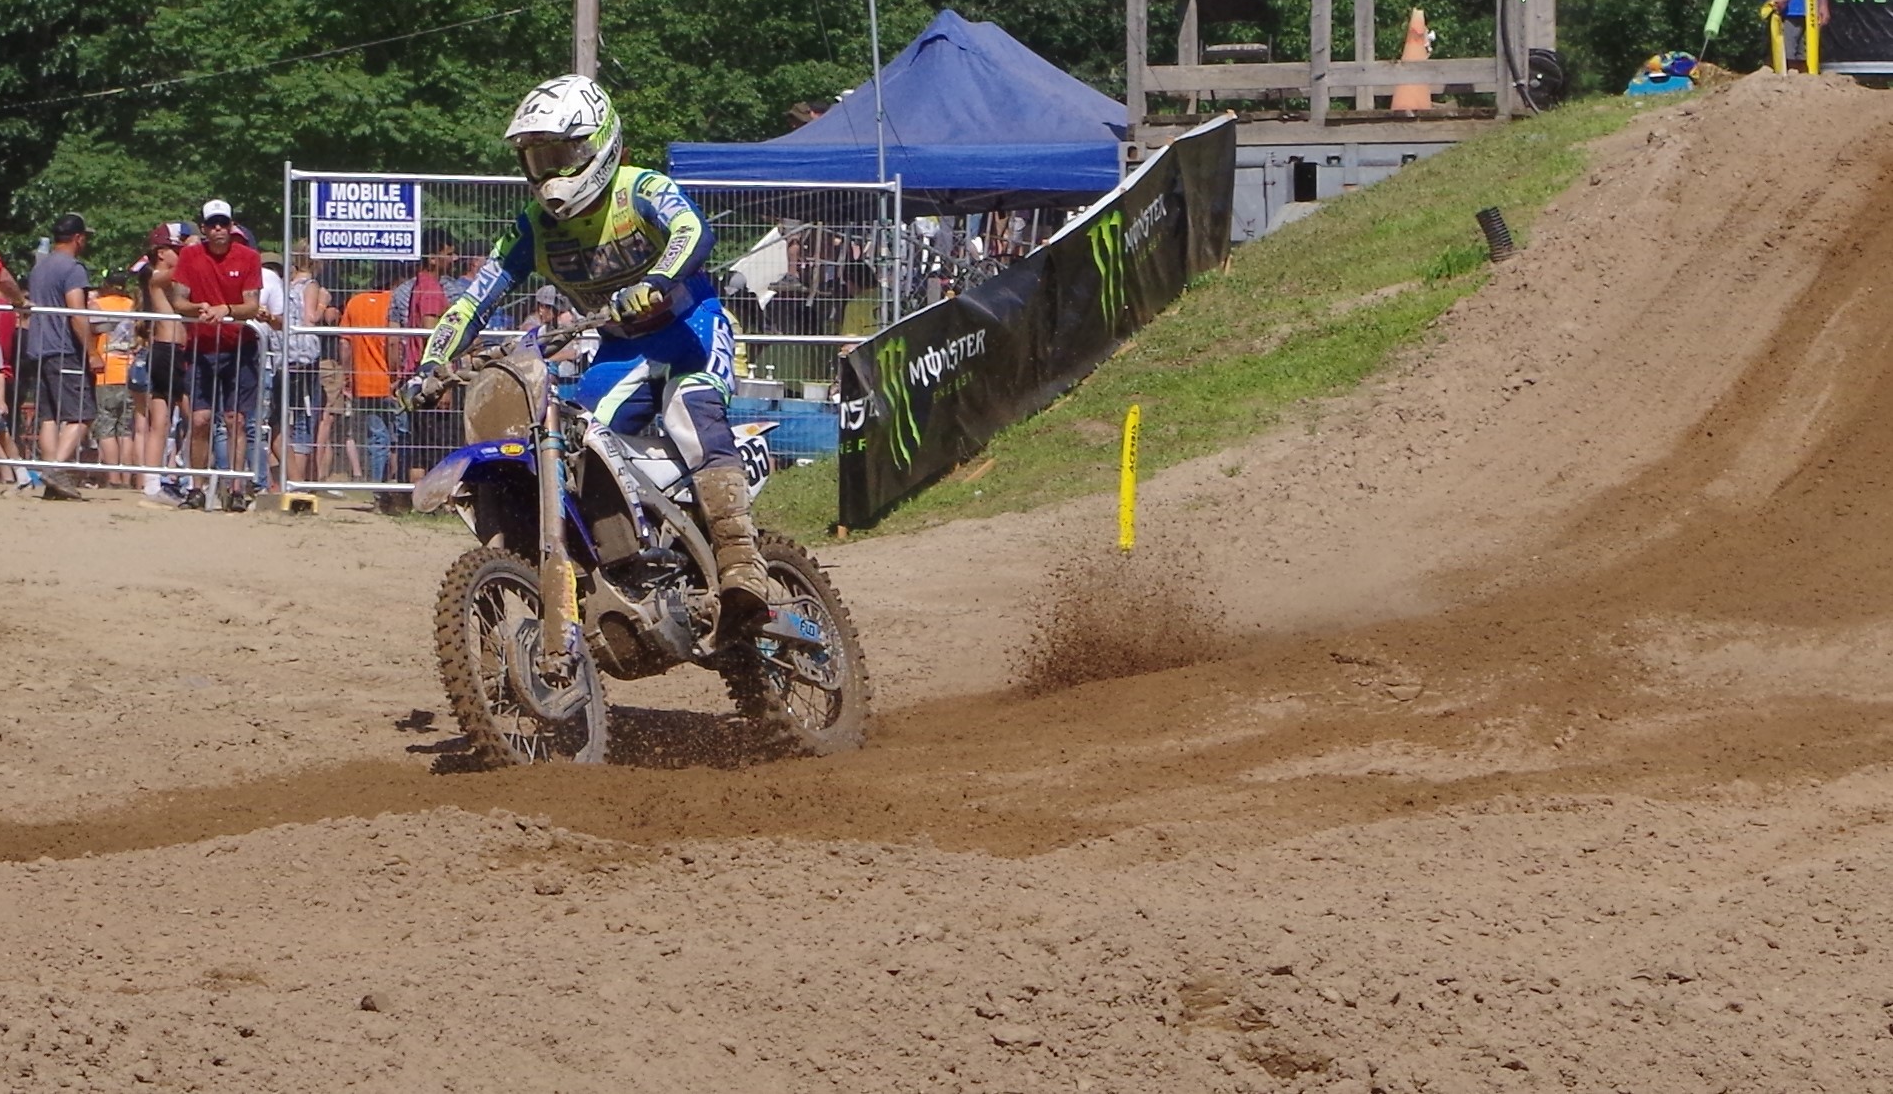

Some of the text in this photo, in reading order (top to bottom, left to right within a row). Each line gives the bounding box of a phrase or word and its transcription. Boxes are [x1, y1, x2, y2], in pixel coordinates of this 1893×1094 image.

[330, 182, 401, 202] MOBILE
[325, 201, 407, 220] FENCING
[908, 328, 987, 388] MONSTER
